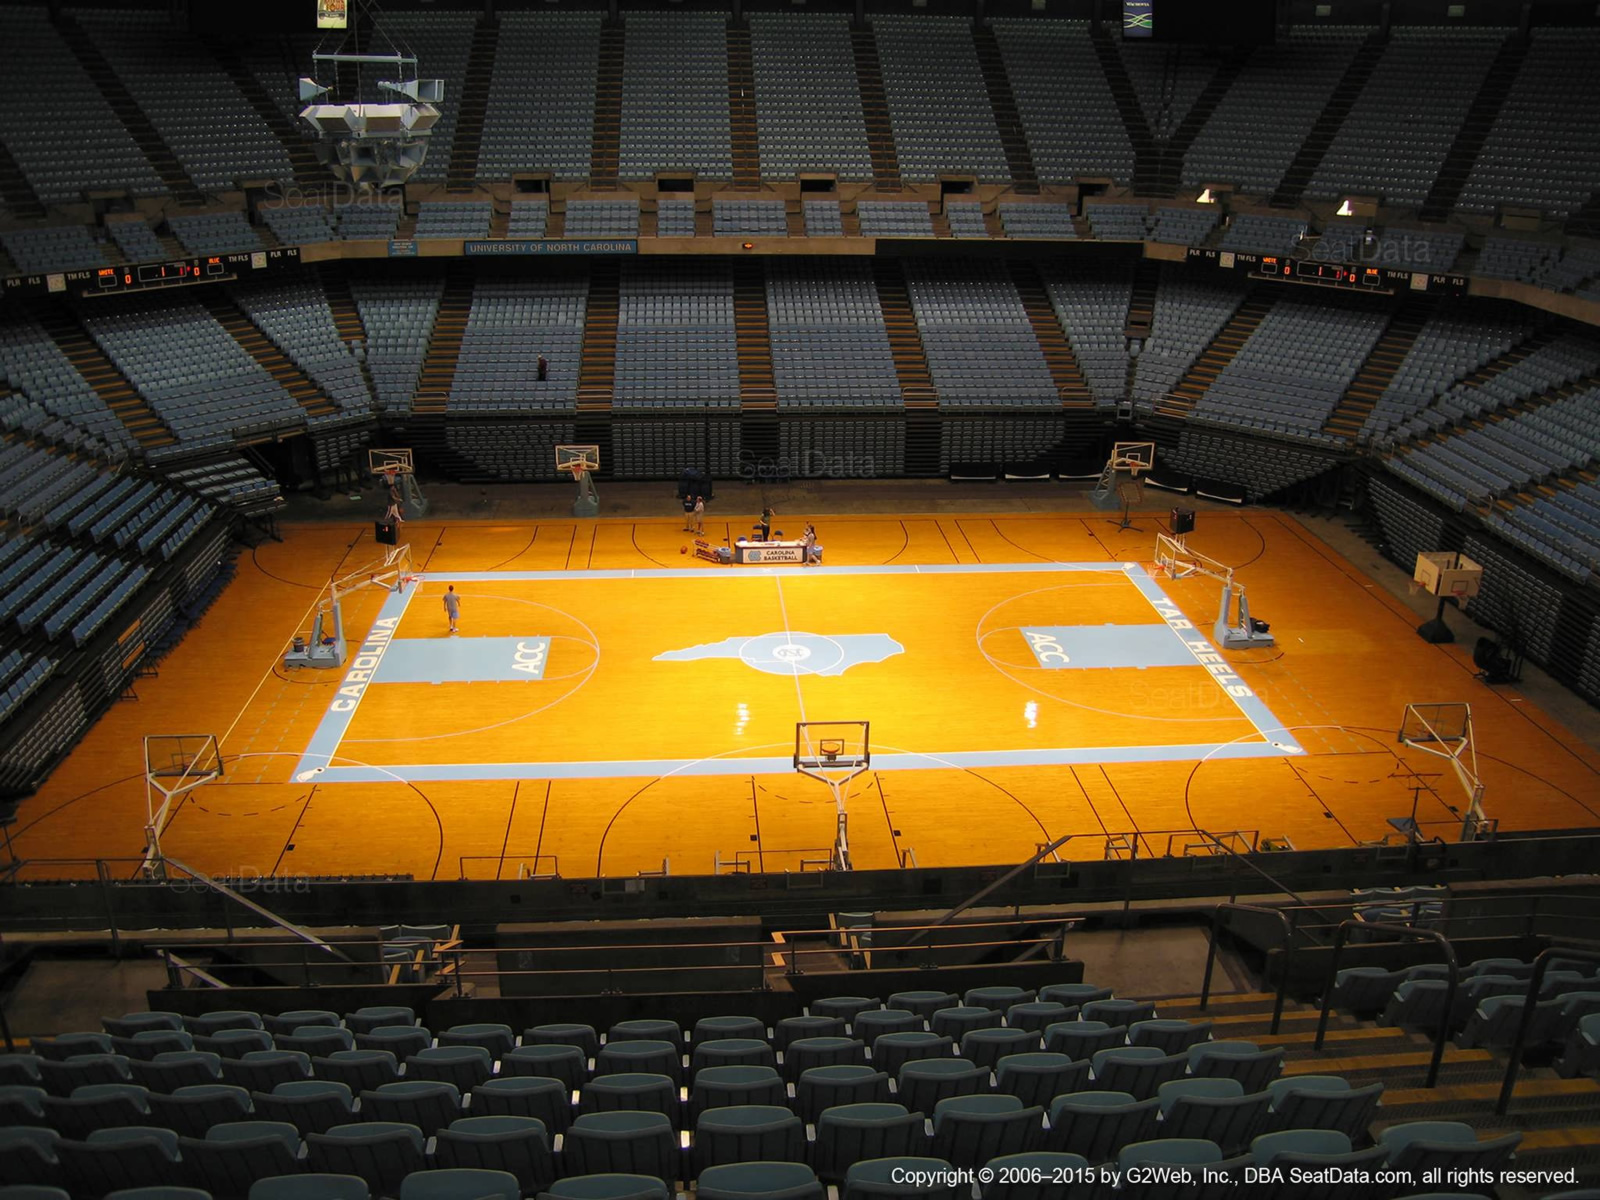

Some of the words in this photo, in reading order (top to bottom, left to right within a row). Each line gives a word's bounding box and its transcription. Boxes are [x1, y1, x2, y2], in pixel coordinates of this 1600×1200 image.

[470, 244, 527, 253] UNIVERSITY
[530, 244, 543, 252] OF
[547, 244, 580, 252] NORTH
[583, 243, 632, 252] CAROLINA
[1189, 248, 1201, 256] PLR
[1205, 250, 1216, 258] FLS
[270, 250, 282, 258] PLR
[193, 267, 200, 276] 0
[1284, 266, 1290, 275] 0
[124, 274, 132, 284] 0
[1348, 273, 1356, 283] 0
[1025, 631, 1070, 663] ACC
[1151, 597, 1194, 629] TAR
[1186, 641, 1254, 697] HEELS
[511, 641, 546, 675] ACC
[331, 616, 399, 712] CAROLINA
